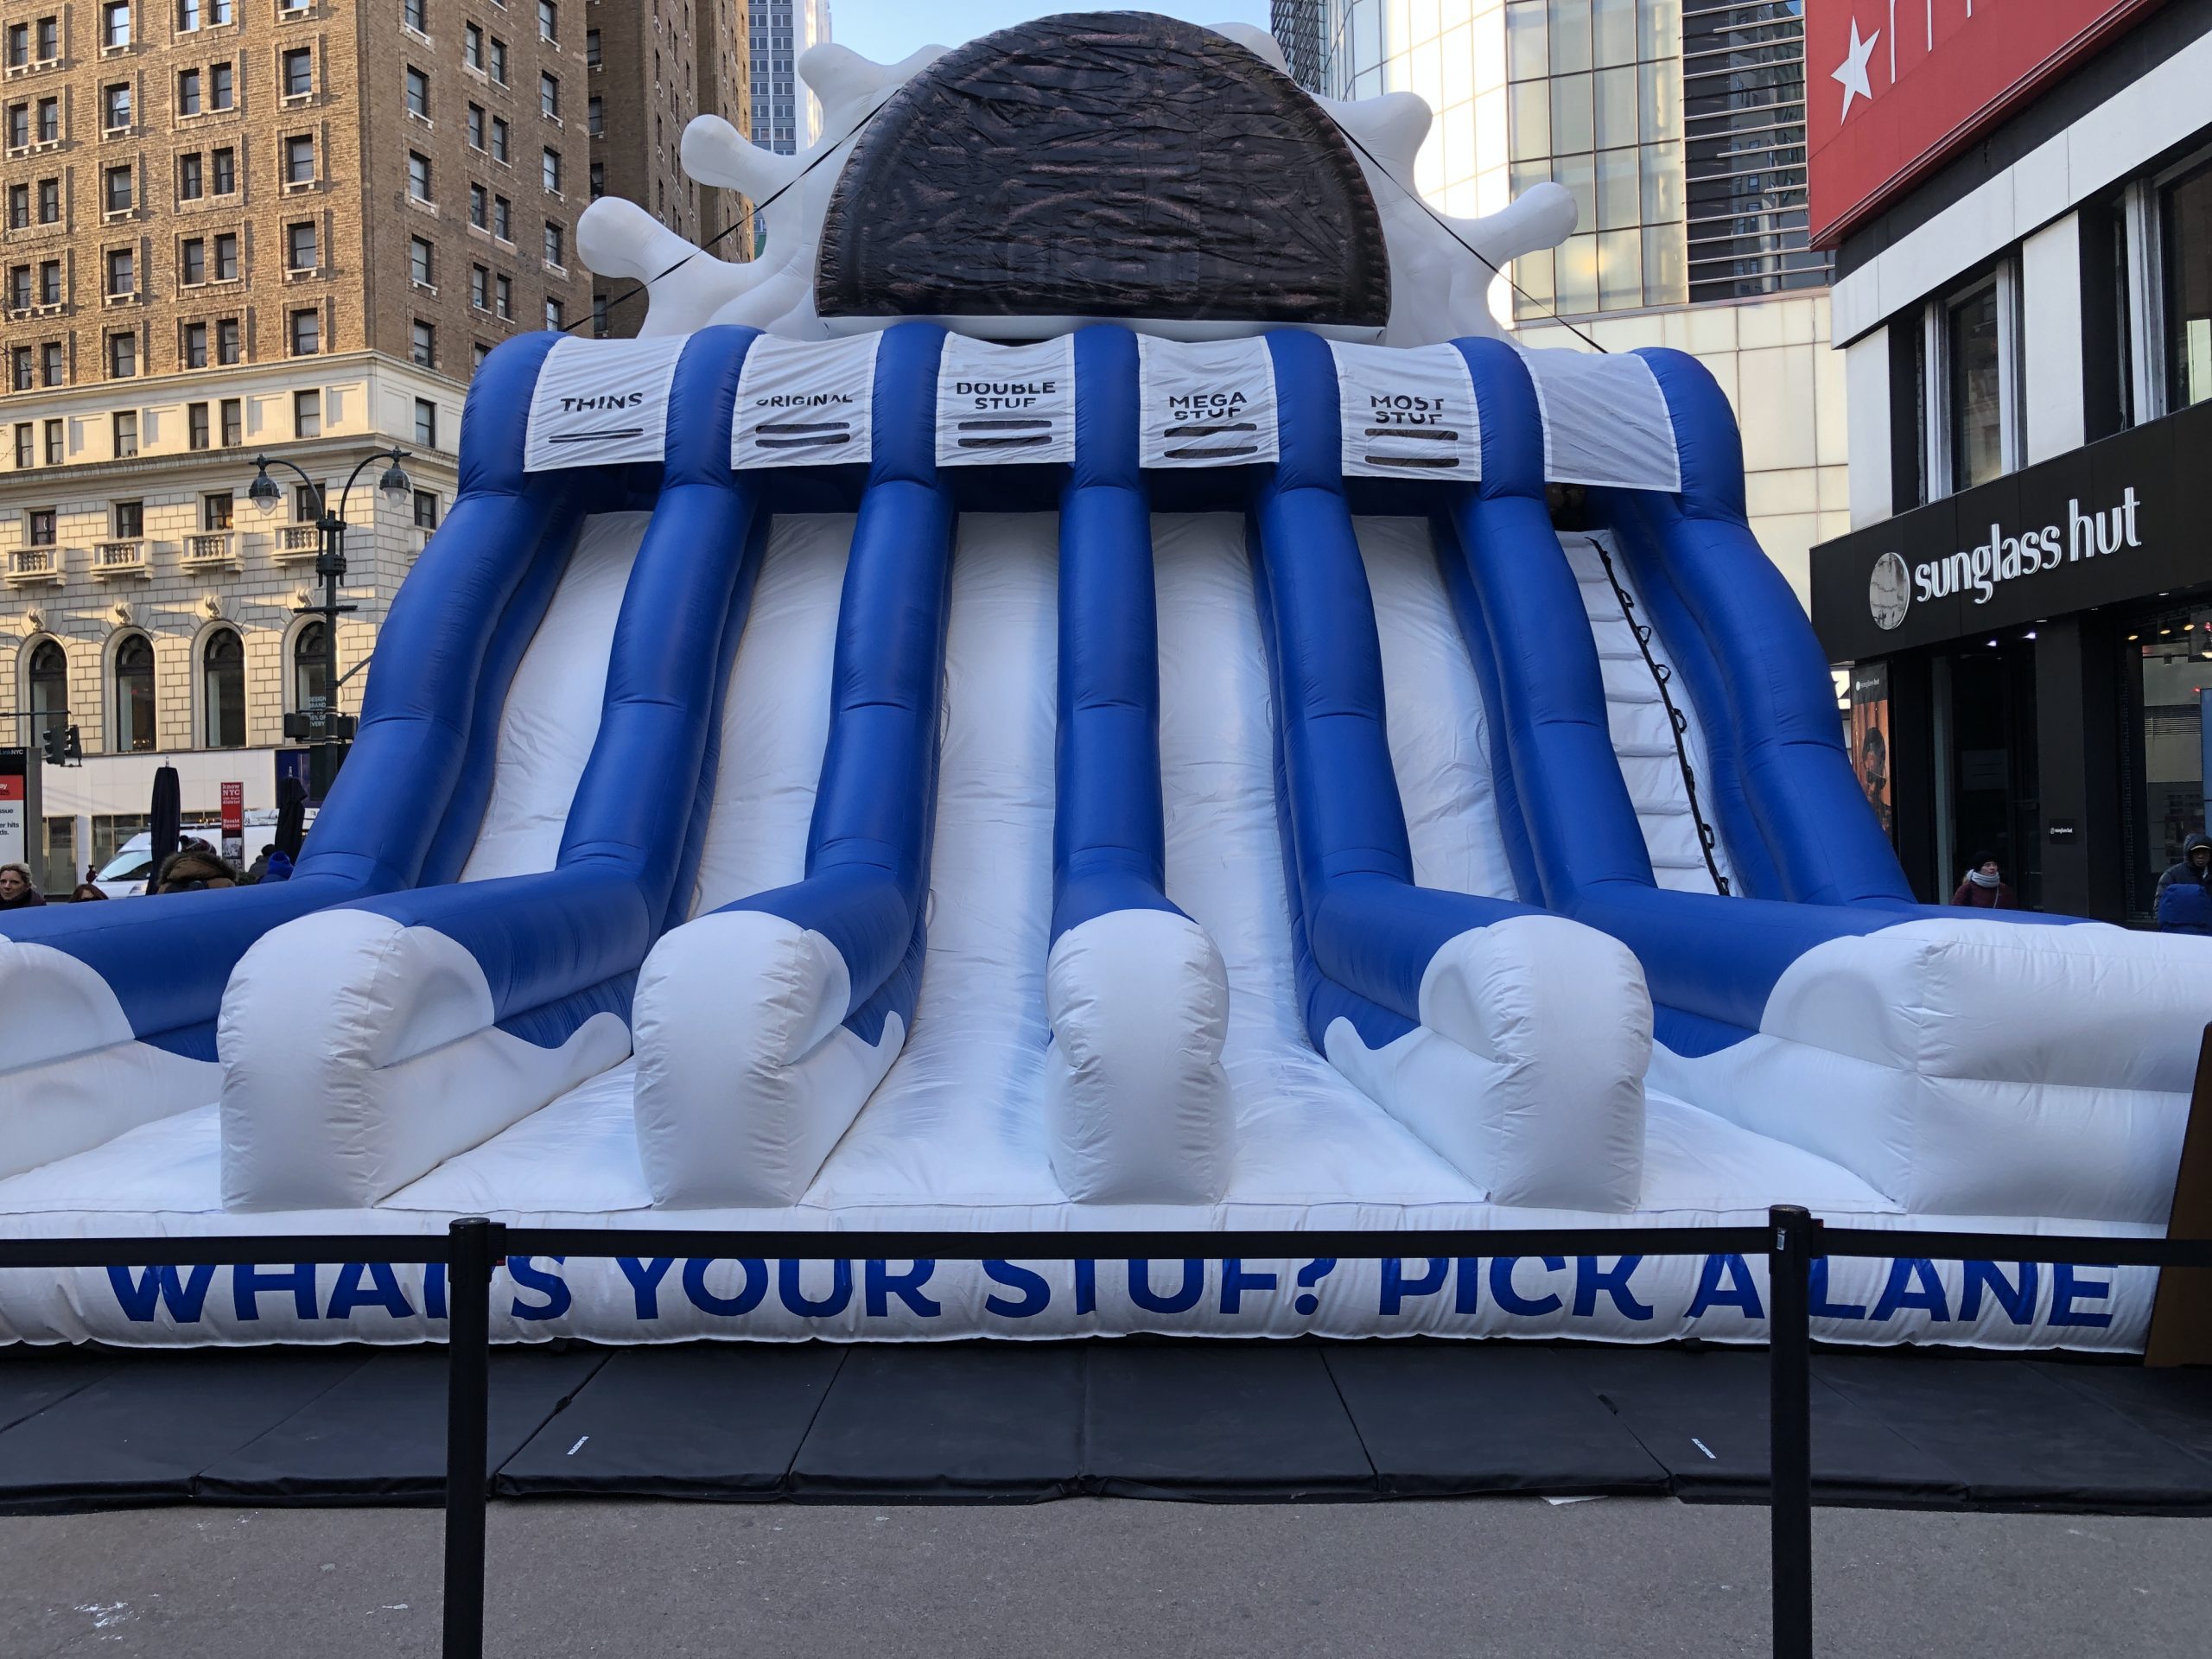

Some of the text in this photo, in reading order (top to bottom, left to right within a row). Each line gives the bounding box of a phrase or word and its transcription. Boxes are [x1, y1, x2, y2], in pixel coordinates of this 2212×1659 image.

[956, 380, 1057, 396] DOUBLE
[560, 391, 644, 412] THINS
[755, 392, 854, 408] ORIGINAL
[974, 397, 1037, 411] STUF
[1168, 391, 1248, 409] MEGA
[1370, 394, 1446, 411] MOST
[1173, 407, 1242, 421] STUF
[1373, 409, 1444, 424] STUF
[1915, 486, 2142, 605] sunglass hut
[105, 1255, 572, 1323] WHATS
[614, 1256, 942, 1319] YOUR
[1378, 1255, 1654, 1320] PICK
[1682, 1253, 1766, 1319] A
[1808, 1255, 2119, 1328] LANE
